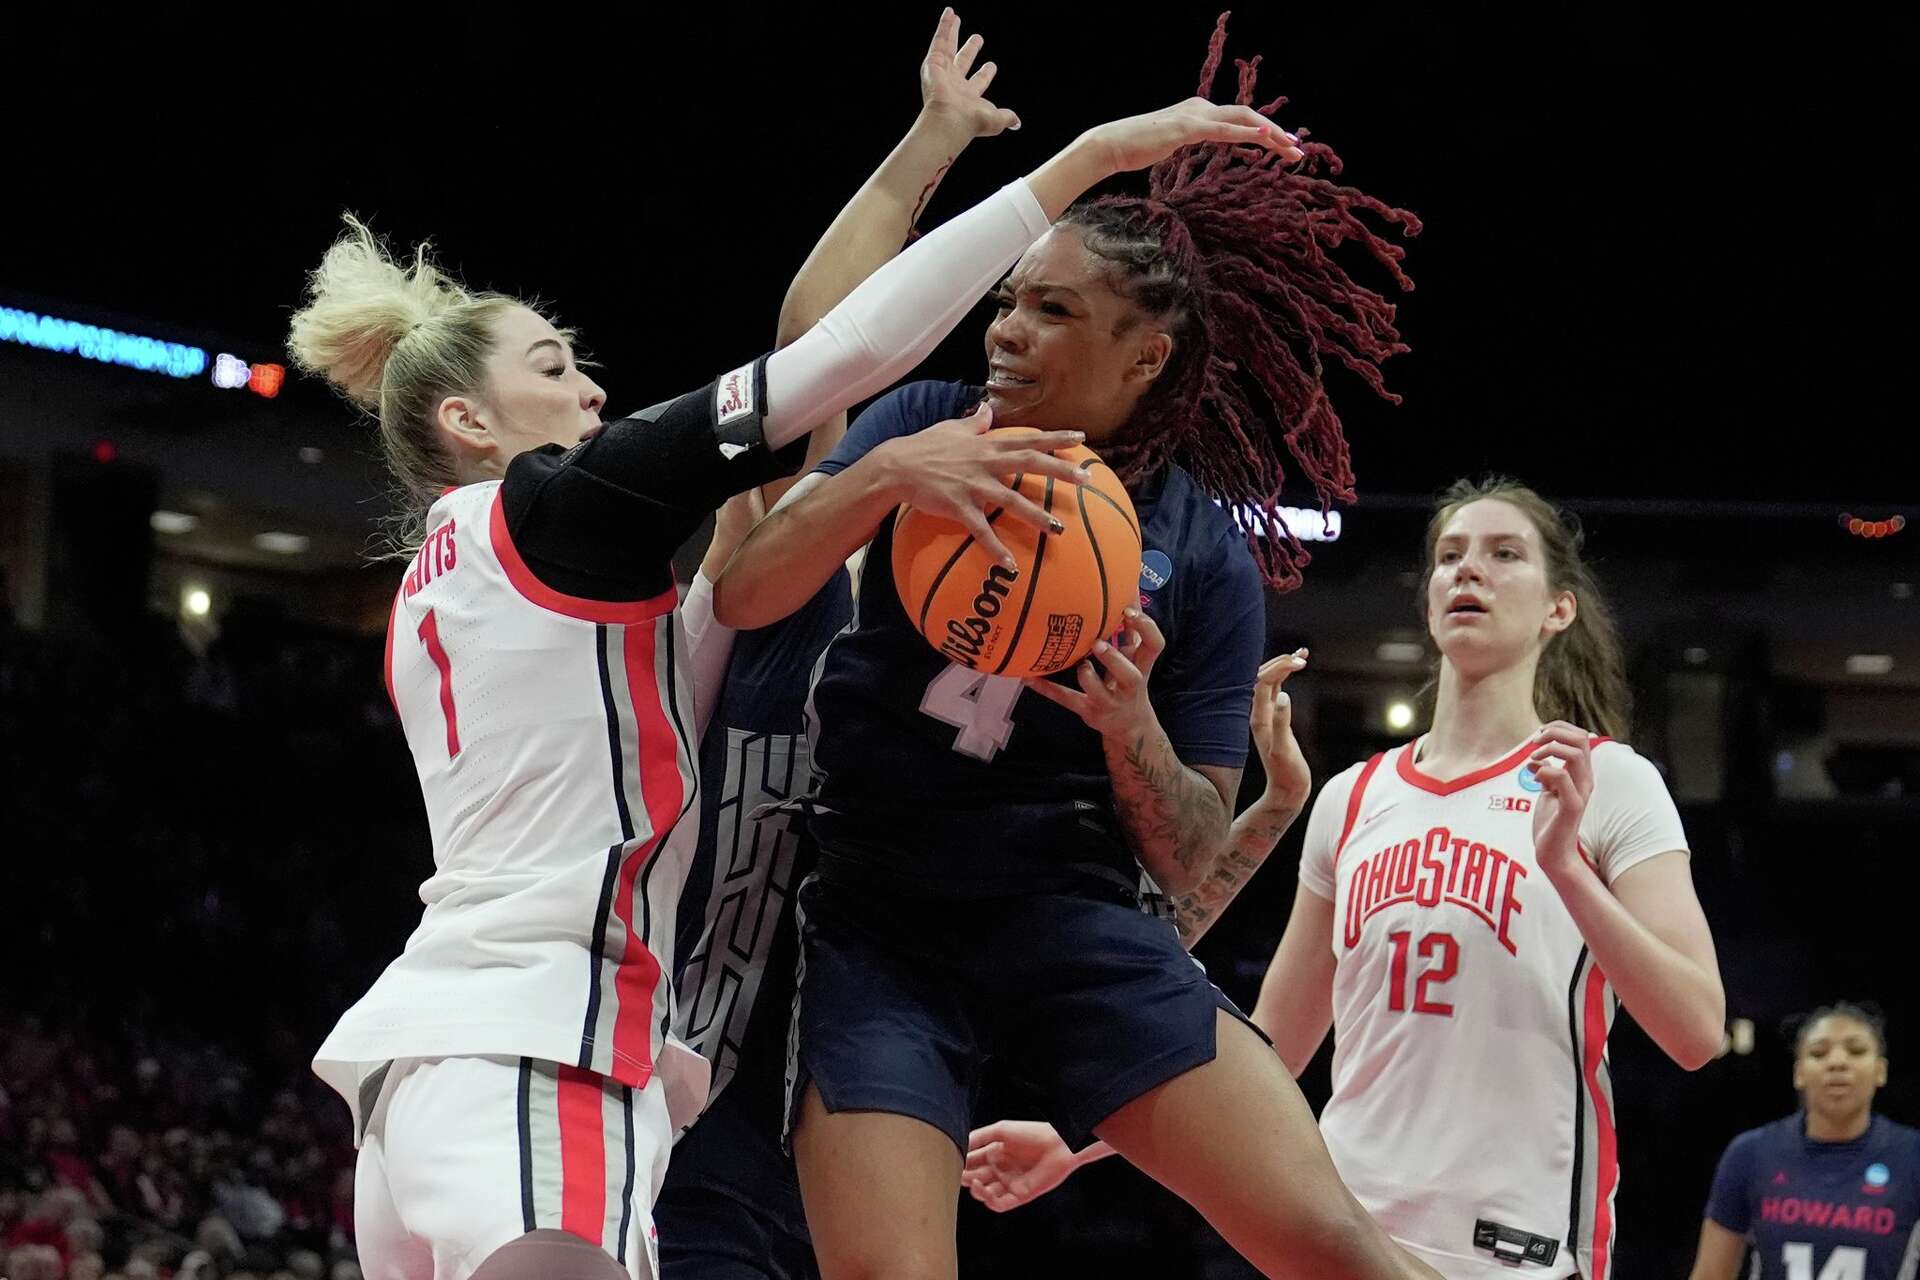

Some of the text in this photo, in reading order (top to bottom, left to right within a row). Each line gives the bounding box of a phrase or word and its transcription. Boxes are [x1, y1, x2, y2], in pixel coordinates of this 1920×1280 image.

[410, 608, 460, 759] 1
[919, 662, 1025, 763] 4
[1344, 838, 1421, 949] OHIO
[1416, 826, 1527, 957] STATE
[1388, 930, 1460, 1018] 12
[1761, 1198, 1895, 1235] HOWARD
